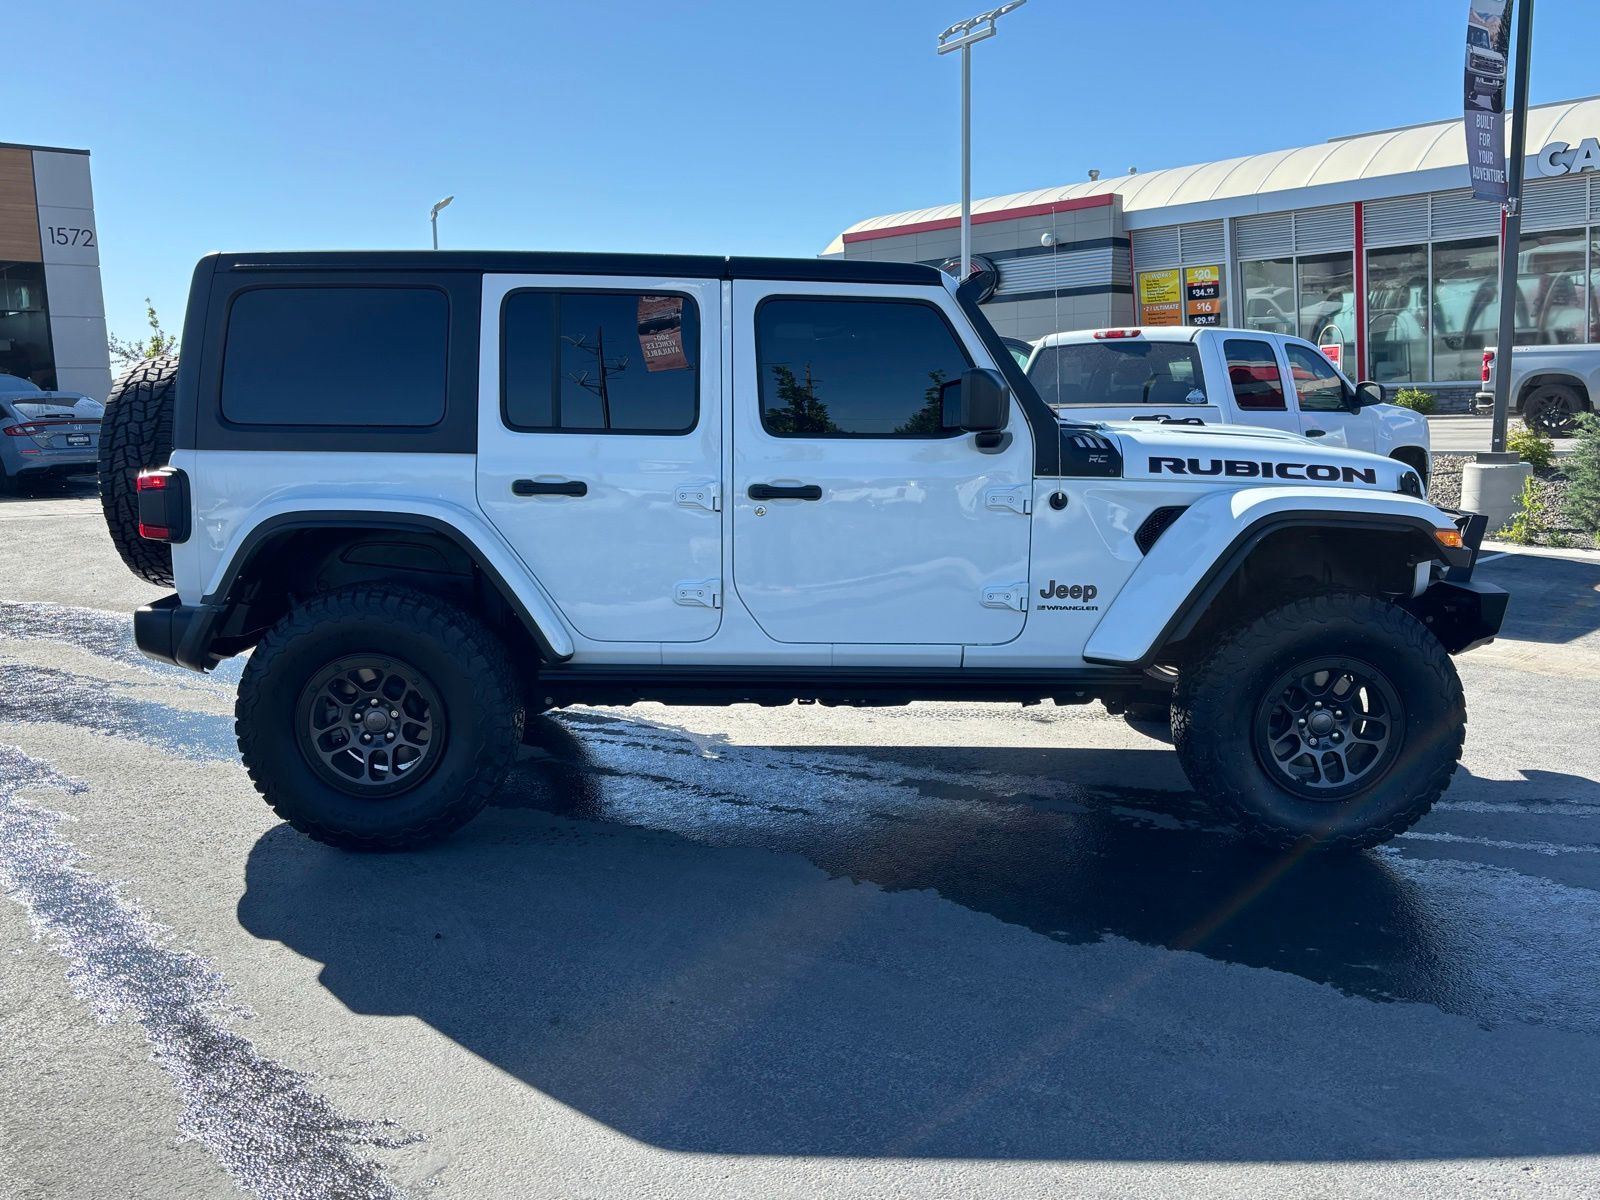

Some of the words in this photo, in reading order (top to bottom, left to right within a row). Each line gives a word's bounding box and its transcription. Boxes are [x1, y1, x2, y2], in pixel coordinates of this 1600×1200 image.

[1475, 114, 1494, 130] BUILT
[1479, 132, 1491, 147] FOR
[1478, 151, 1494, 165] YOUR
[1537, 137, 1600, 177] CA
[1472, 166, 1505, 184] ADVENTURE
[48, 226, 95, 247] 1572
[1194, 269, 1211, 279] $20
[1192, 288, 1214, 297] $34.99
[1196, 302, 1212, 312] $16
[1088, 454, 1108, 463] RC
[1148, 456, 1377, 484] RUBICON
[1040, 579, 1098, 603] Jeep
